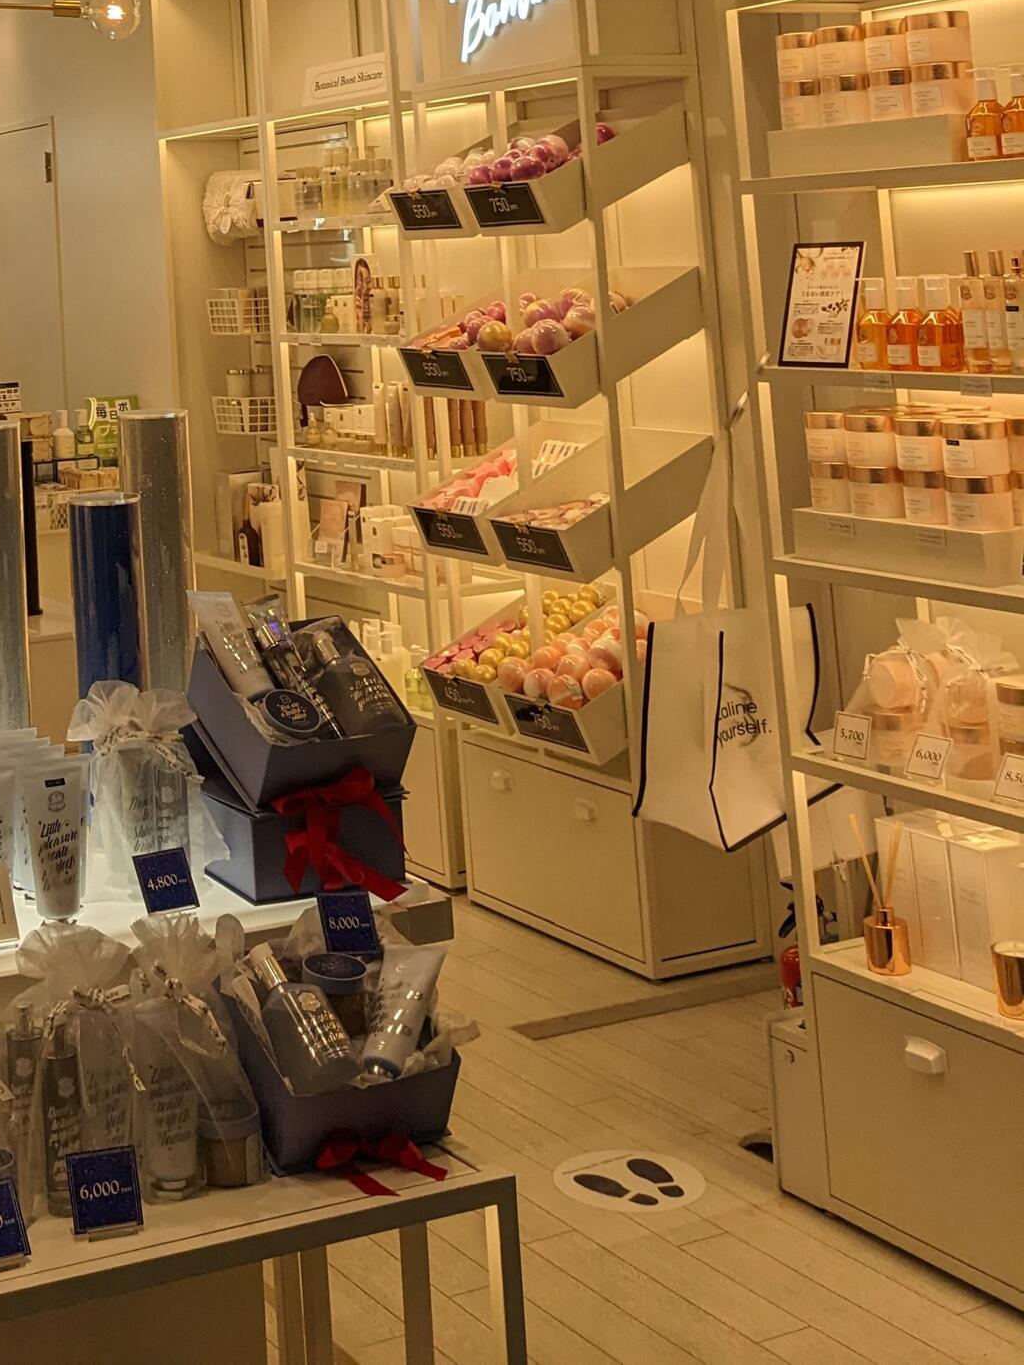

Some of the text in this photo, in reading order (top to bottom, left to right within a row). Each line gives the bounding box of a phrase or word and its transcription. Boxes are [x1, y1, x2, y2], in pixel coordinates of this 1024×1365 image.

[314, 71, 383, 92] Botanical Boost Skincare
[412, 204, 431, 219] 550
[488, 197, 510, 213] 750
[423, 362, 442, 377] 550
[506, 366, 526, 383] 750
[437, 523, 455, 539] 550
[516, 537, 537, 554] 550
[531, 712, 552, 731] 750
[839, 728, 865, 742] 5,700
[915, 748, 942, 763] 6,000
[147, 873, 178, 891] 4,800
[329, 916, 360, 930] 8,000
[80, 1179, 120, 1201] 6,000
